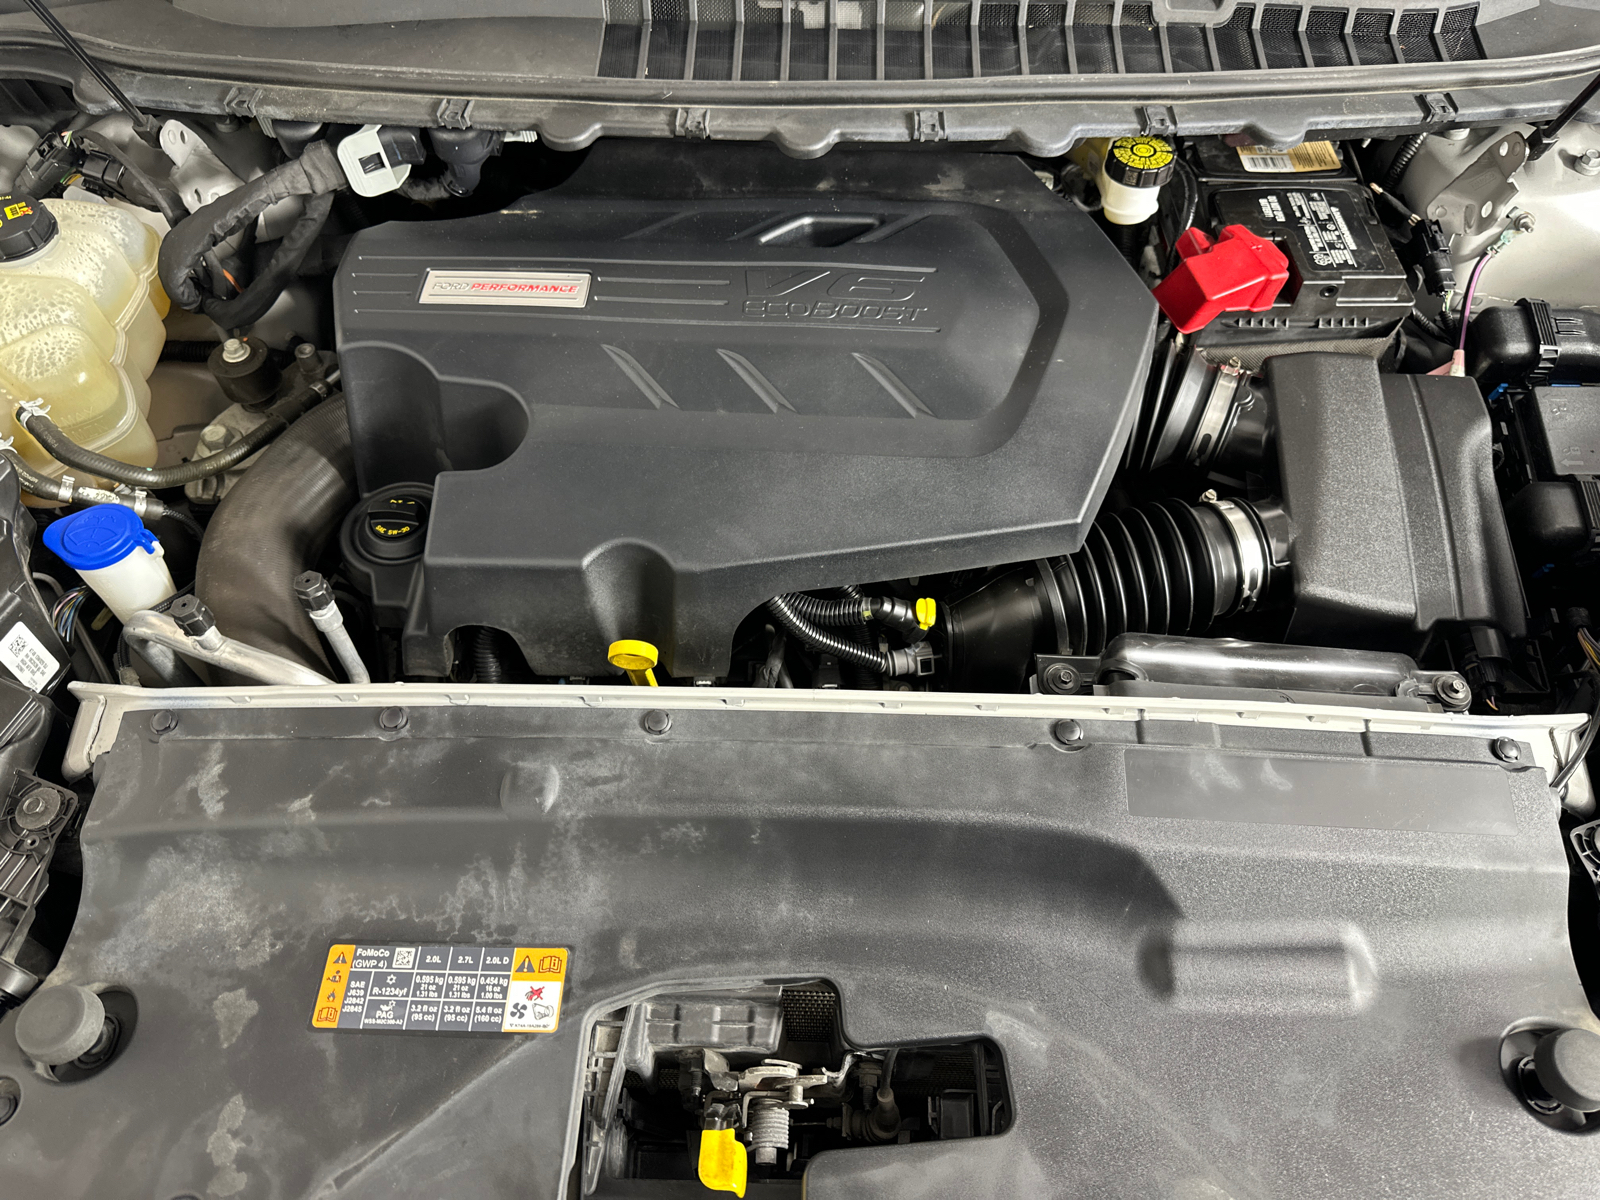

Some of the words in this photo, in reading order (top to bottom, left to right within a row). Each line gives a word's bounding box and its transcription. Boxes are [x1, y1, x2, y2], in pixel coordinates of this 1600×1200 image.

[432, 282, 470, 291] FORD
[471, 283, 580, 294] PERFORMANCE
[745, 270, 925, 301] V6
[356, 948, 390, 957] FoMoCo
[426, 955, 441, 963] 2.0L
[458, 956, 473, 964] 2.7L
[486, 956, 501, 964] 2.0L
[352, 959, 377, 969] (GWP
[378, 960, 387, 970] 4)
[416, 975, 434, 984] 0.595
[435, 976, 444, 986] kg
[448, 976, 467, 985] 0.595
[467, 976, 476, 986] kg
[480, 976, 499, 985] 0.454
[499, 977, 508, 987] kg
[372, 987, 408, 997] R-1234yf
[411, 1004, 422, 1012] 3.2
[443, 1005, 454, 1013] 3.2
[375, 1010, 394, 1019] PAG
[411, 1013, 423, 1022] (95
[423, 1014, 435, 1022] cc)
[444, 1014, 455, 1022] (95
[455, 1015, 468, 1023] cc)
[474, 1015, 489, 1023] (160
[490, 1015, 502, 1024] cc)
